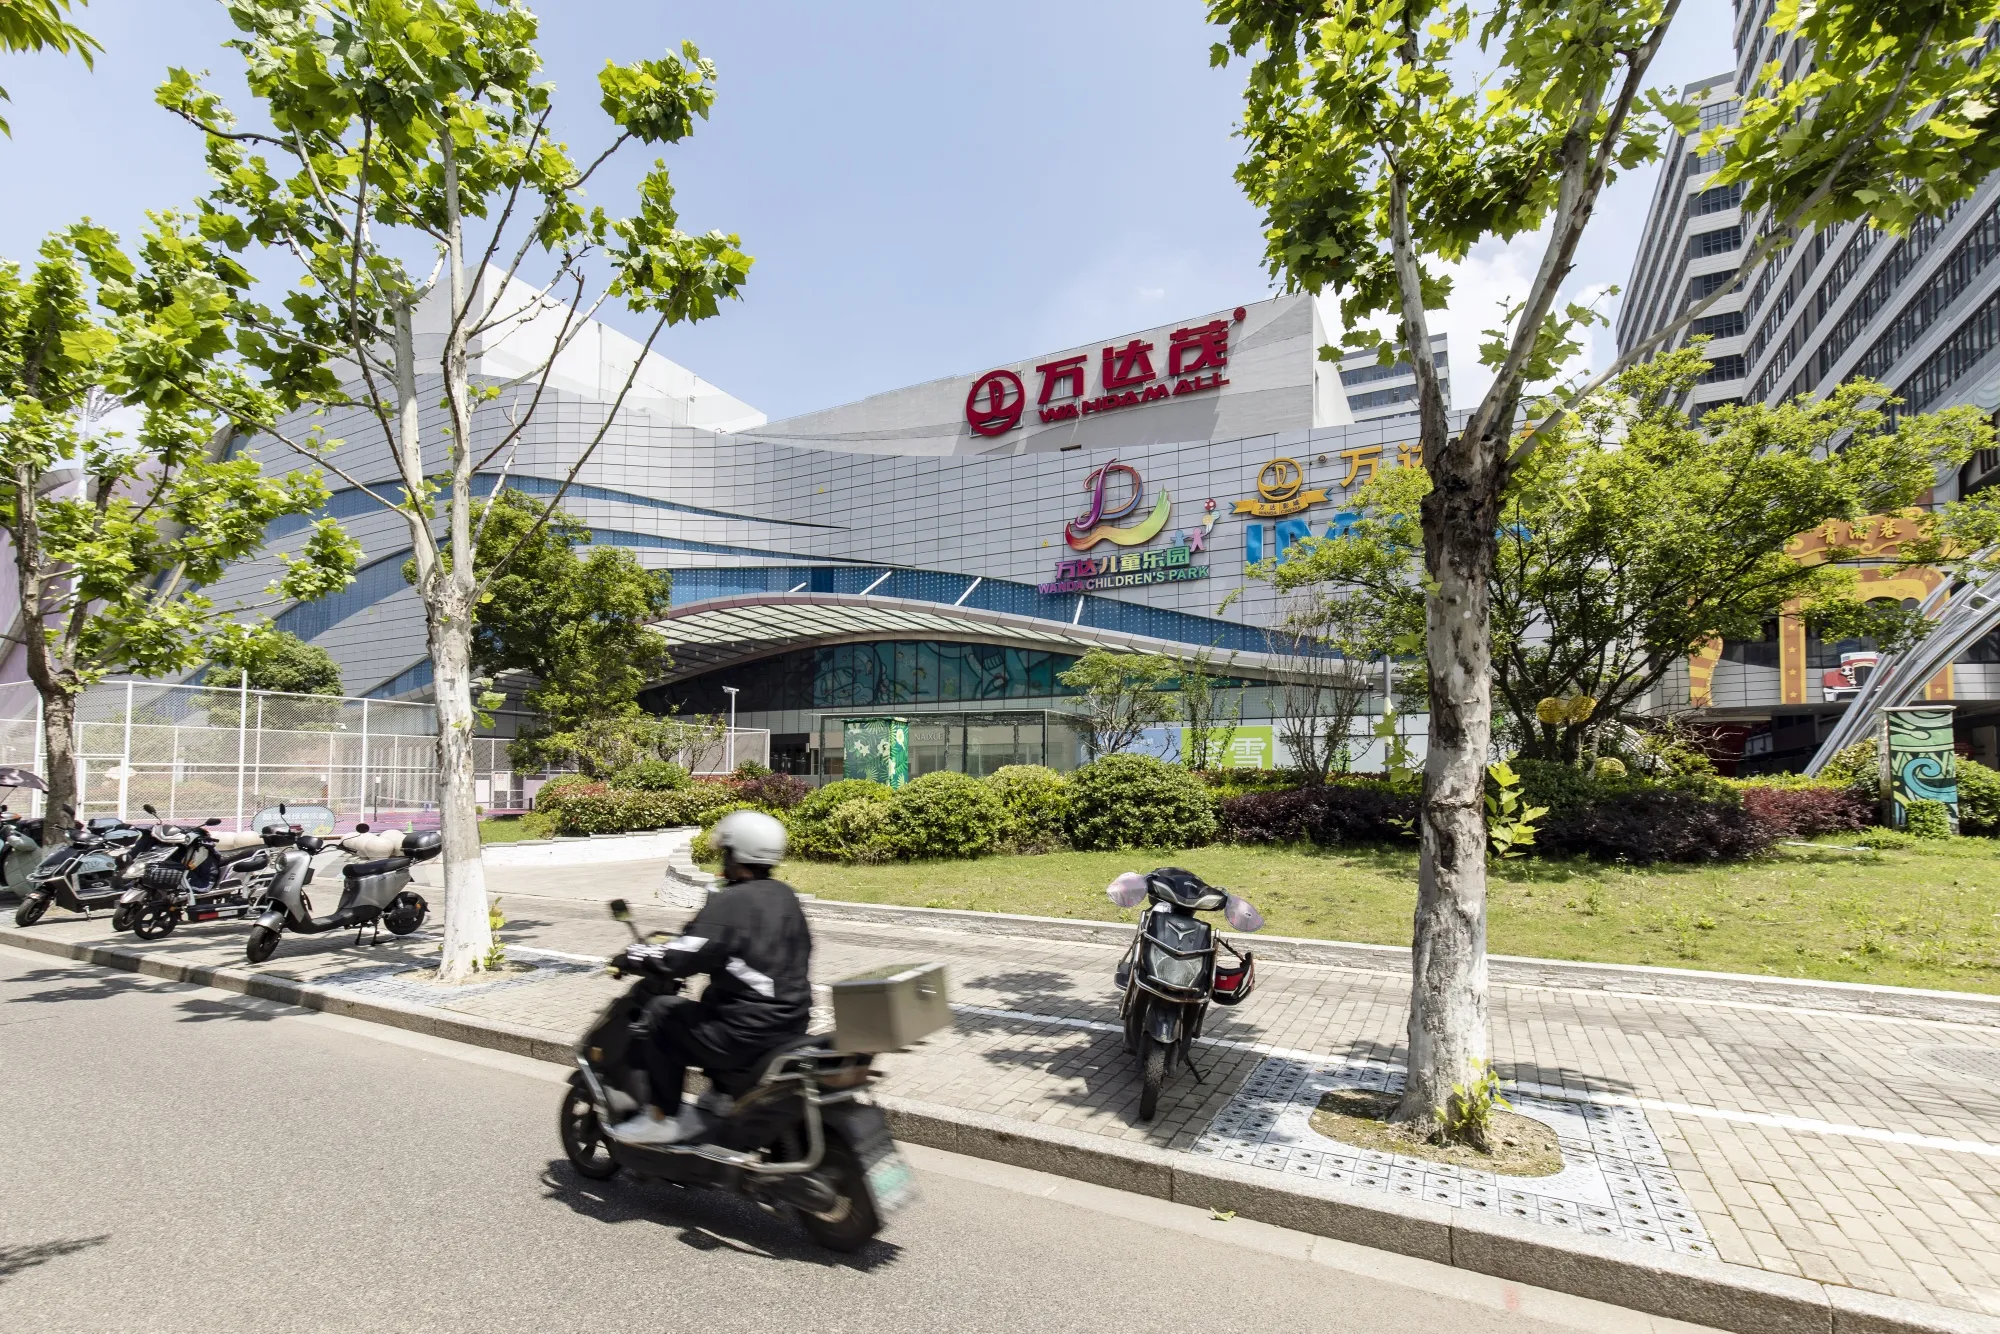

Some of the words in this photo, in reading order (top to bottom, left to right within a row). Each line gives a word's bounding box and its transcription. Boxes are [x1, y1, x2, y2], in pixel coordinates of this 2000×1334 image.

[1035, 319, 1230, 405] 万达茂
[1038, 579, 1084, 594] WANDA
[1086, 569, 1165, 590] CHILDREN'S
[1168, 564, 1211, 581] PARK
[1055, 545, 1191, 579] 万达儿童乐园
